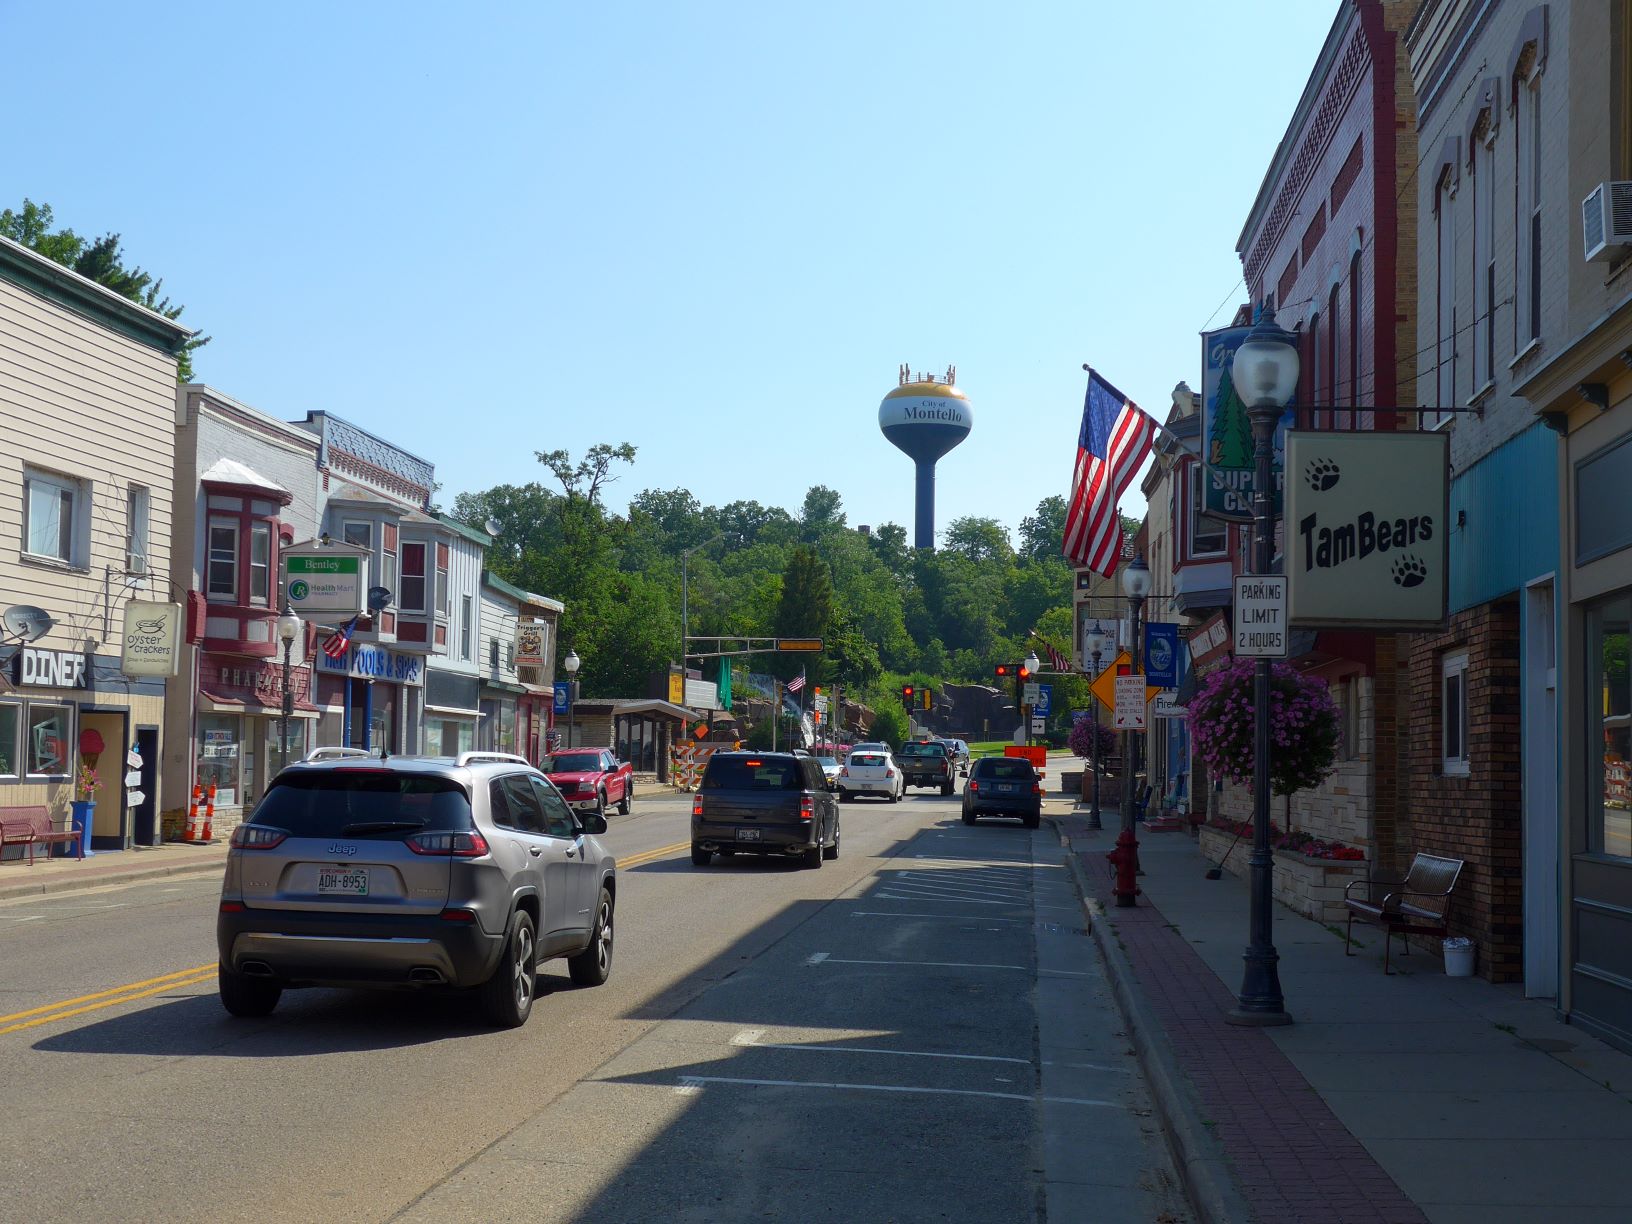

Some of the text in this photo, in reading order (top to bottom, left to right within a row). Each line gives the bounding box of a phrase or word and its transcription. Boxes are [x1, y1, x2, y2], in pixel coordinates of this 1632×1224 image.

[922, 400, 937, 408] City
[904, 407, 962, 422] Montello
[1213, 471, 1285, 490] SUPR
[1301, 511, 1433, 572] TamBears
[305, 560, 340, 571] Bentley
[311, 584, 336, 592] Health
[1242, 585, 1281, 599] PARKING
[1242, 608, 1280, 623] LIMIT
[1240, 633, 1245, 647] 2
[1249, 633, 1282, 647] HOURS
[22, 648, 86, 688] DINER
[352, 646, 385, 675] POOLS
[386, 652, 393, 677] &
[395, 654, 417, 682] SPAS
[222, 667, 300, 692] PHARMAY
[328, 843, 357, 856] Jeep
[319, 874, 367, 889] ADH-8953
